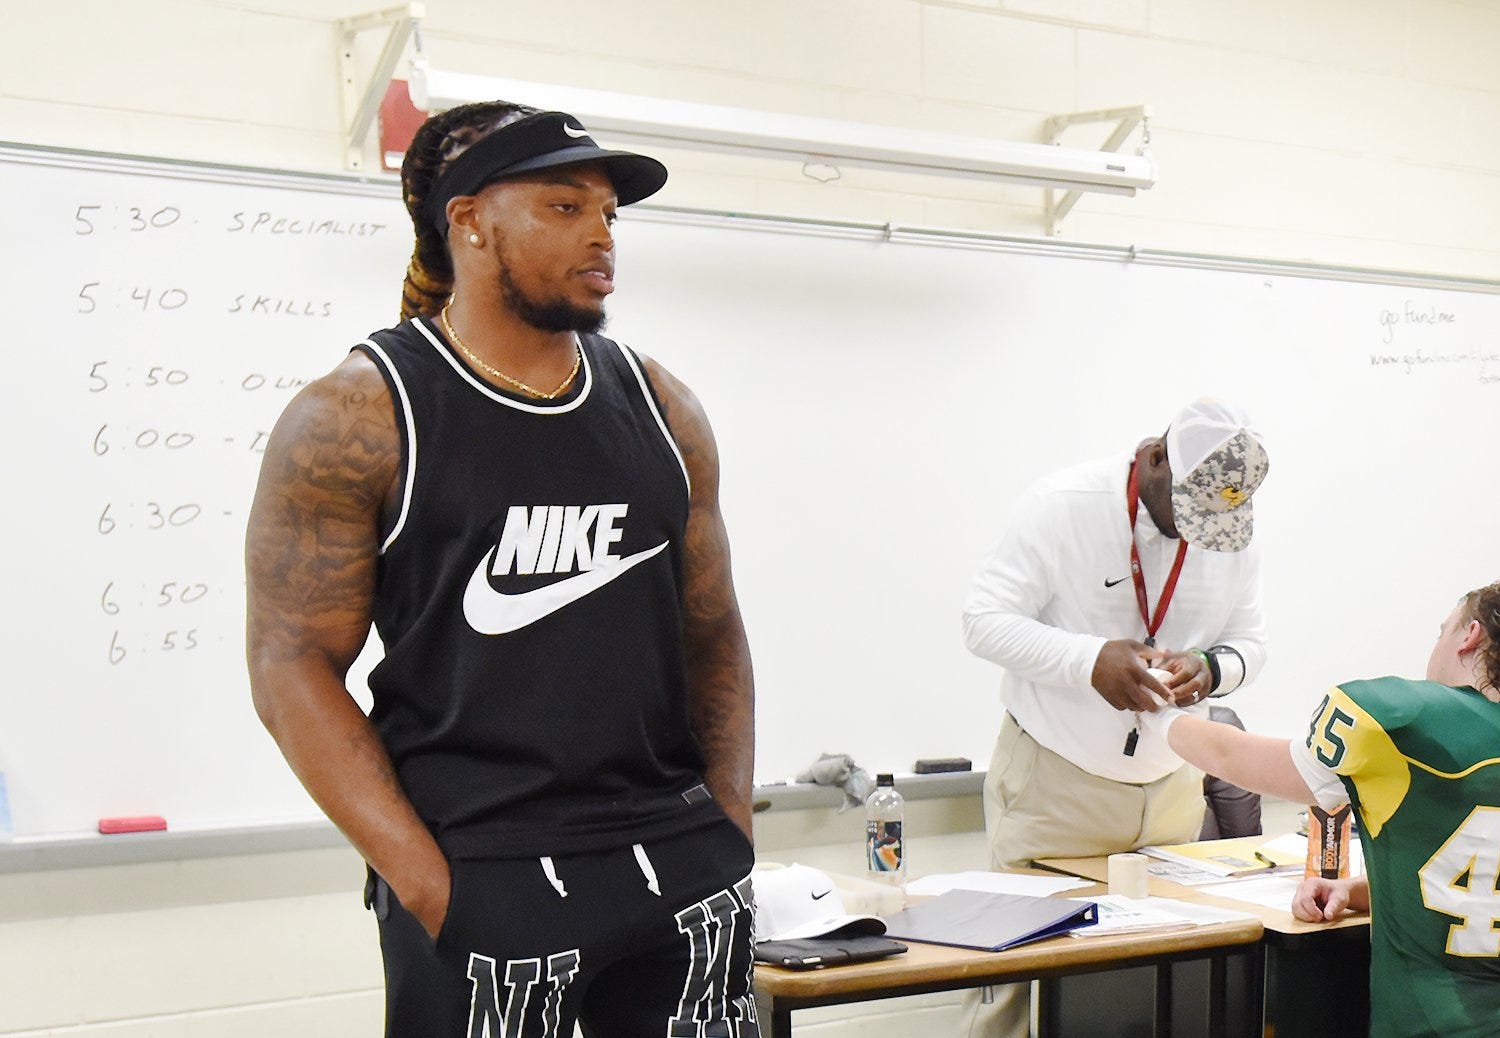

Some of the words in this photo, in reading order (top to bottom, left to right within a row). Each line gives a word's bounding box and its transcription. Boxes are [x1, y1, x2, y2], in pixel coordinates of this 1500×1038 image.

[74, 205, 181, 236] 5:30
[227, 210, 391, 240] SPECIALIST
[77, 282, 189, 314] 5:40
[228, 293, 334, 318] SKILLS
[88, 361, 189, 392] 5:50
[93, 423, 194, 456] 6:00
[97, 502, 201, 535] 6:30
[492, 503, 630, 576] NIKE
[101, 581, 209, 616] 6:50
[108, 629, 200, 666] 6:55
[1325, 817, 1336, 870] BODYARMOR
